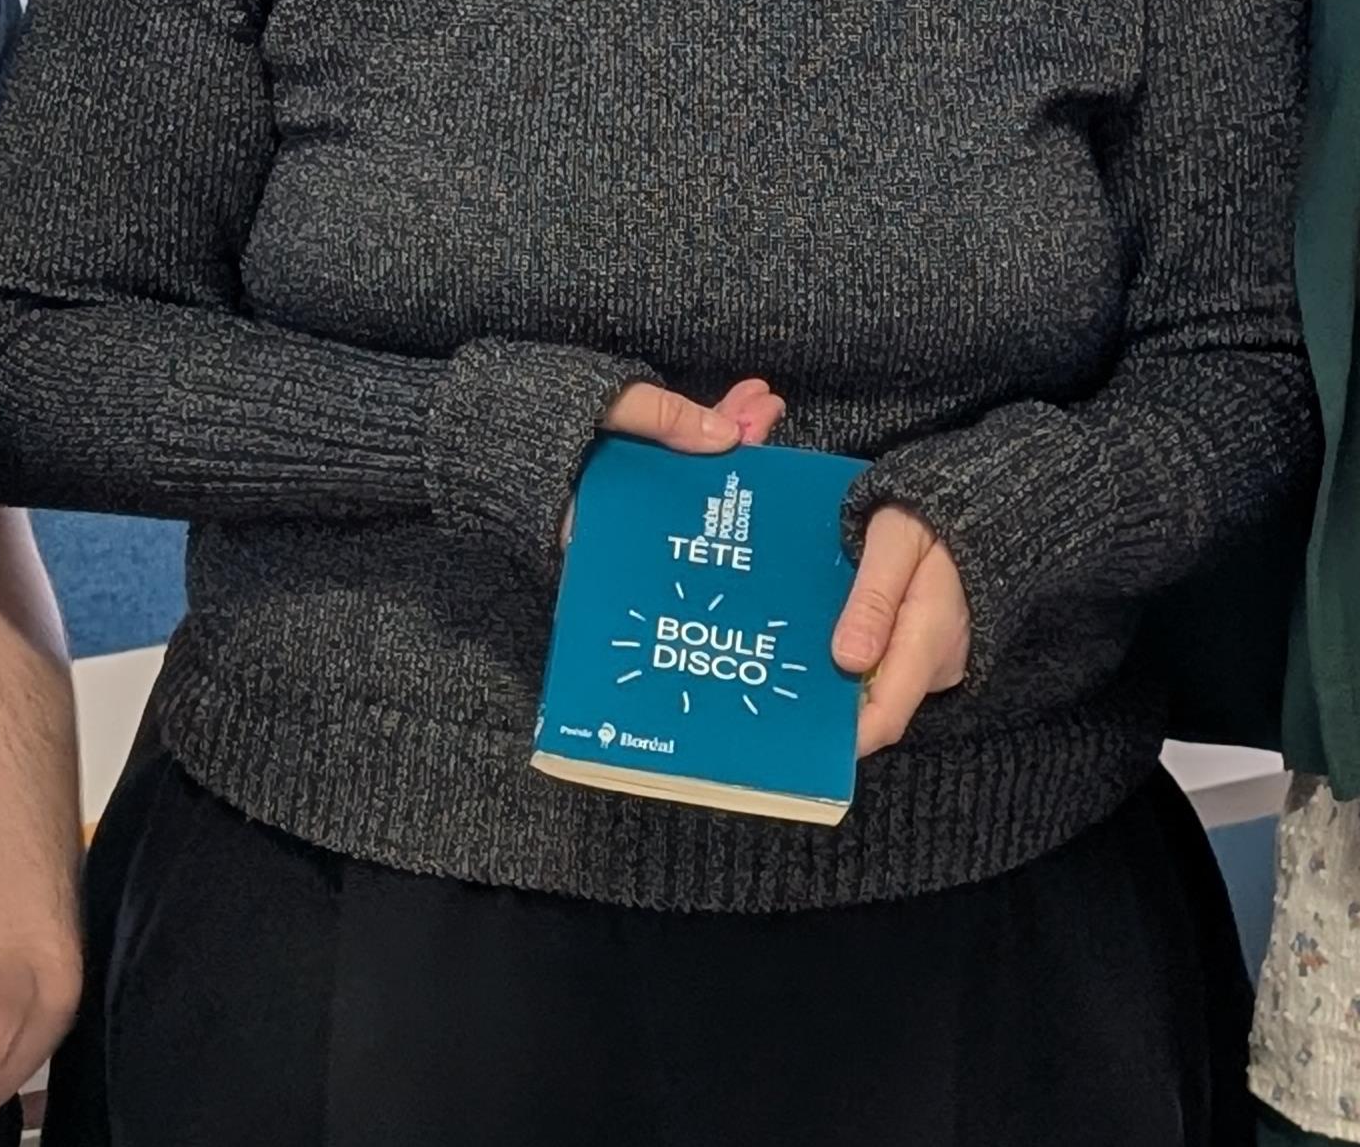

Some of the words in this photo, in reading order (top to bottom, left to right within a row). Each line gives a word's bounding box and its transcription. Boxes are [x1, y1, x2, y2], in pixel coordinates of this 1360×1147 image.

[667, 534, 753, 572] TÊTE
[656, 615, 777, 661] BOULE
[652, 643, 768, 686] DISCO
[620, 732, 675, 754] Boréal
